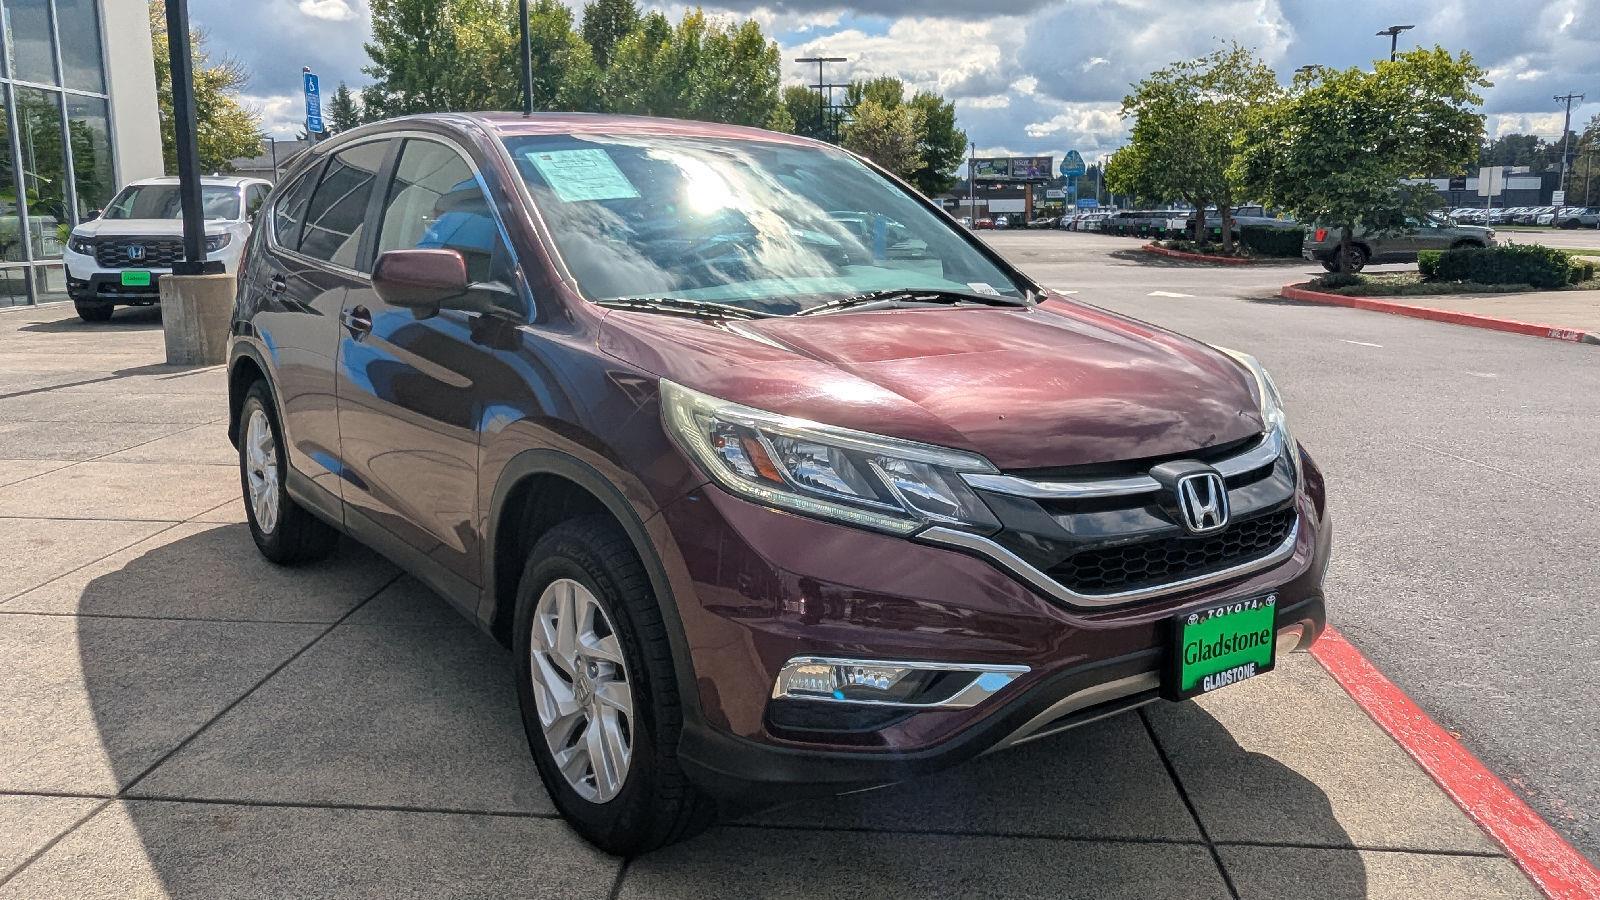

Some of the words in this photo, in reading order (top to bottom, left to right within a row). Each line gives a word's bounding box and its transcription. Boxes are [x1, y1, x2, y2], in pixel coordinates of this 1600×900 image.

[1207, 599, 1257, 620] TOYOTA
[1184, 628, 1270, 666] Gladstone
[1203, 662, 1256, 692] GLADSTONE
